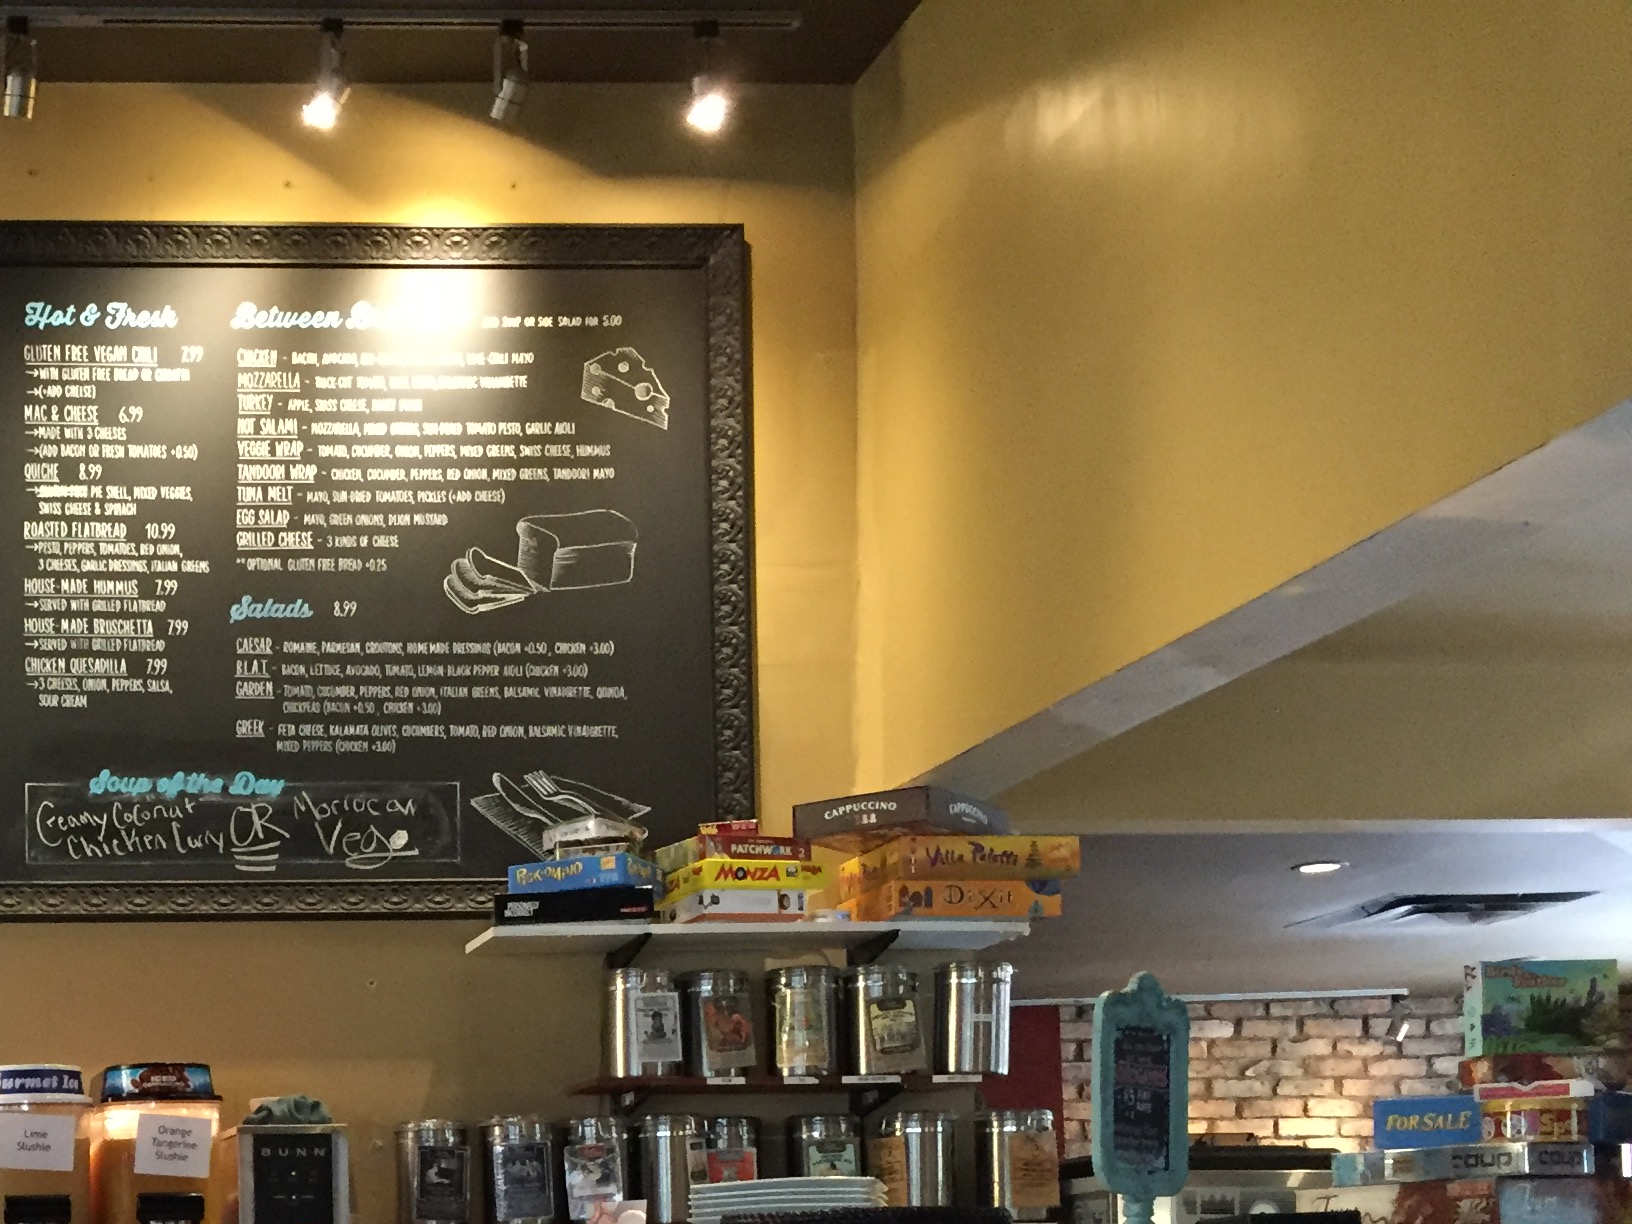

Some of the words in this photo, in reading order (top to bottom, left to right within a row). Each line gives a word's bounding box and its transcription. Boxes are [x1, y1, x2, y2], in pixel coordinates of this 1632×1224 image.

[25, 302, 75, 330] Hot
[104, 303, 177, 330] Fresh
[231, 302, 342, 330] Between
[238, 372, 300, 389] MOZZARELLA
[24, 406, 46, 422] MAC
[64, 406, 99, 422] CHEESE
[119, 406, 143, 423] 6.99
[24, 522, 67, 537] ROASTED
[72, 522, 127, 538] FLATBREAD
[145, 524, 175, 539] 10.99
[230, 596, 313, 623] Salads
[334, 602, 357, 617] 8.99
[237, 638, 272, 654] CAESAR
[25, 658, 65, 674] CHICKEN
[70, 659, 127, 675] QUESADILLA
[146, 659, 167, 675] 7.99
[237, 720, 264, 736] GREEK
[90, 769, 152, 796] Soup
[229, 770, 284, 797] Day
[824, 801, 897, 820] CAPPUCCINO
[231, 802, 290, 847] OR
[731, 843, 792, 856] PATCHWORK
[715, 864, 780, 882] MONZA
[1386, 1115, 1419, 1131] FOR
[1424, 1111, 1472, 1129] SALE
[158, 1125, 192, 1136] Orange
[17, 1141, 51, 1151] Slushie
[152, 1138, 197, 1150] Tangerine
[260, 1148, 326, 1157] BUNN
[156, 1151, 188, 1161] Slushie
